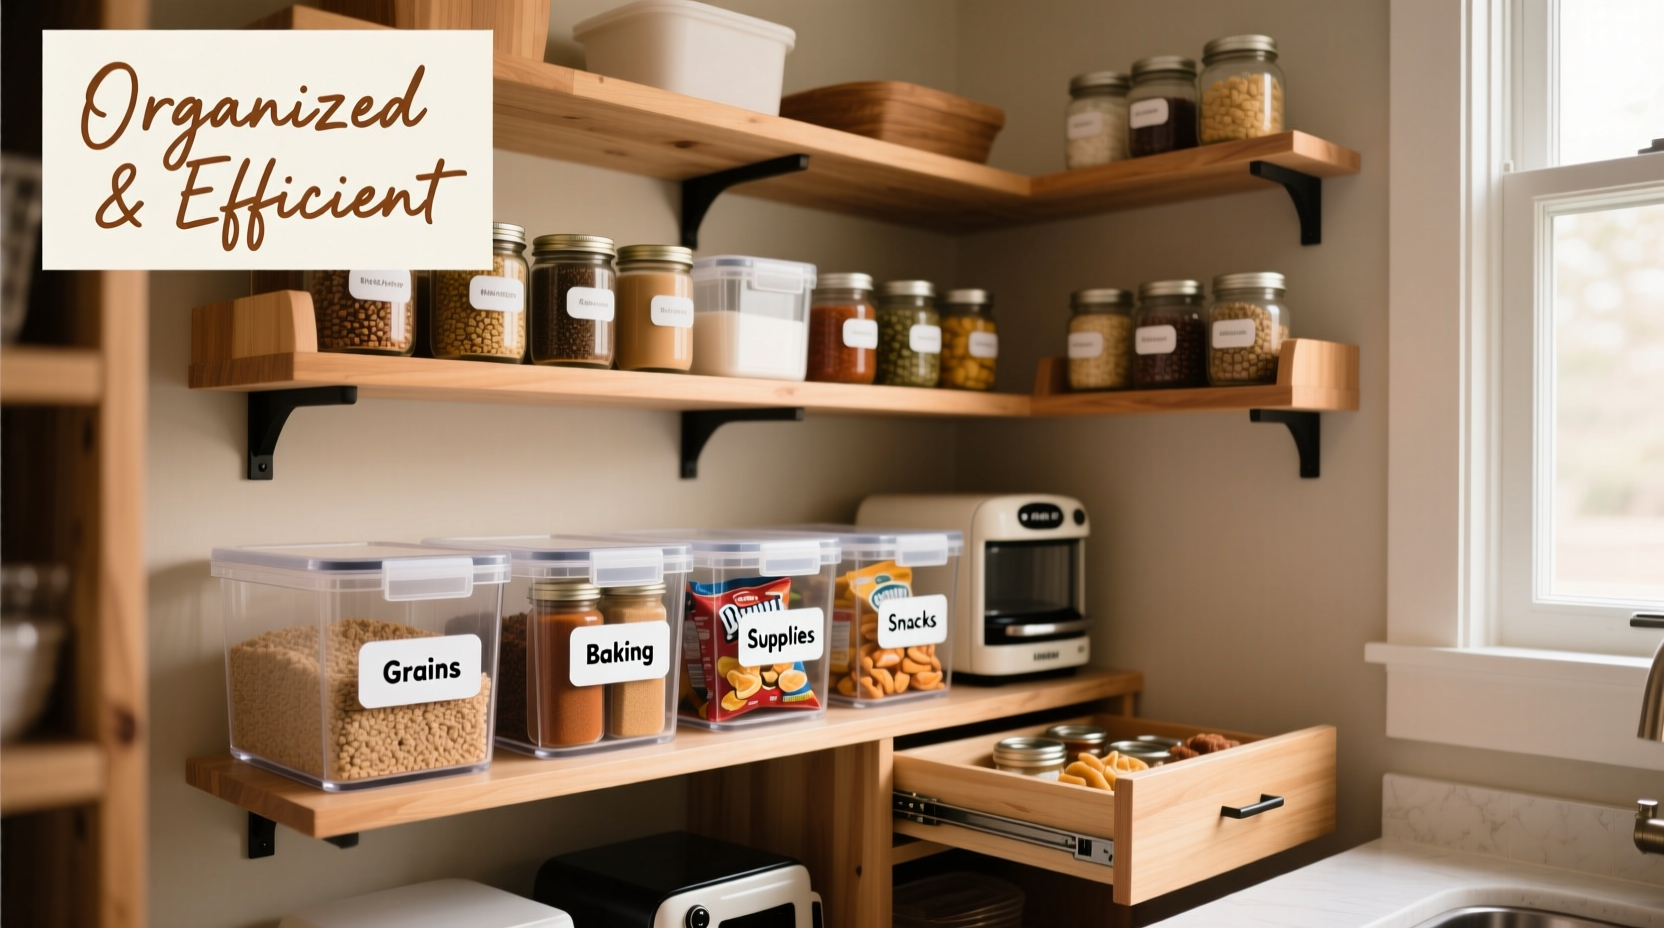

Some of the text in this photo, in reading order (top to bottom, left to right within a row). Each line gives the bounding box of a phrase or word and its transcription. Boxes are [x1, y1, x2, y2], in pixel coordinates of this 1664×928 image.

[888, 610, 937, 632] Snacks
[747, 625, 815, 653] Supplies
[586, 641, 654, 666] Baking
[383, 657, 461, 684] Grains
